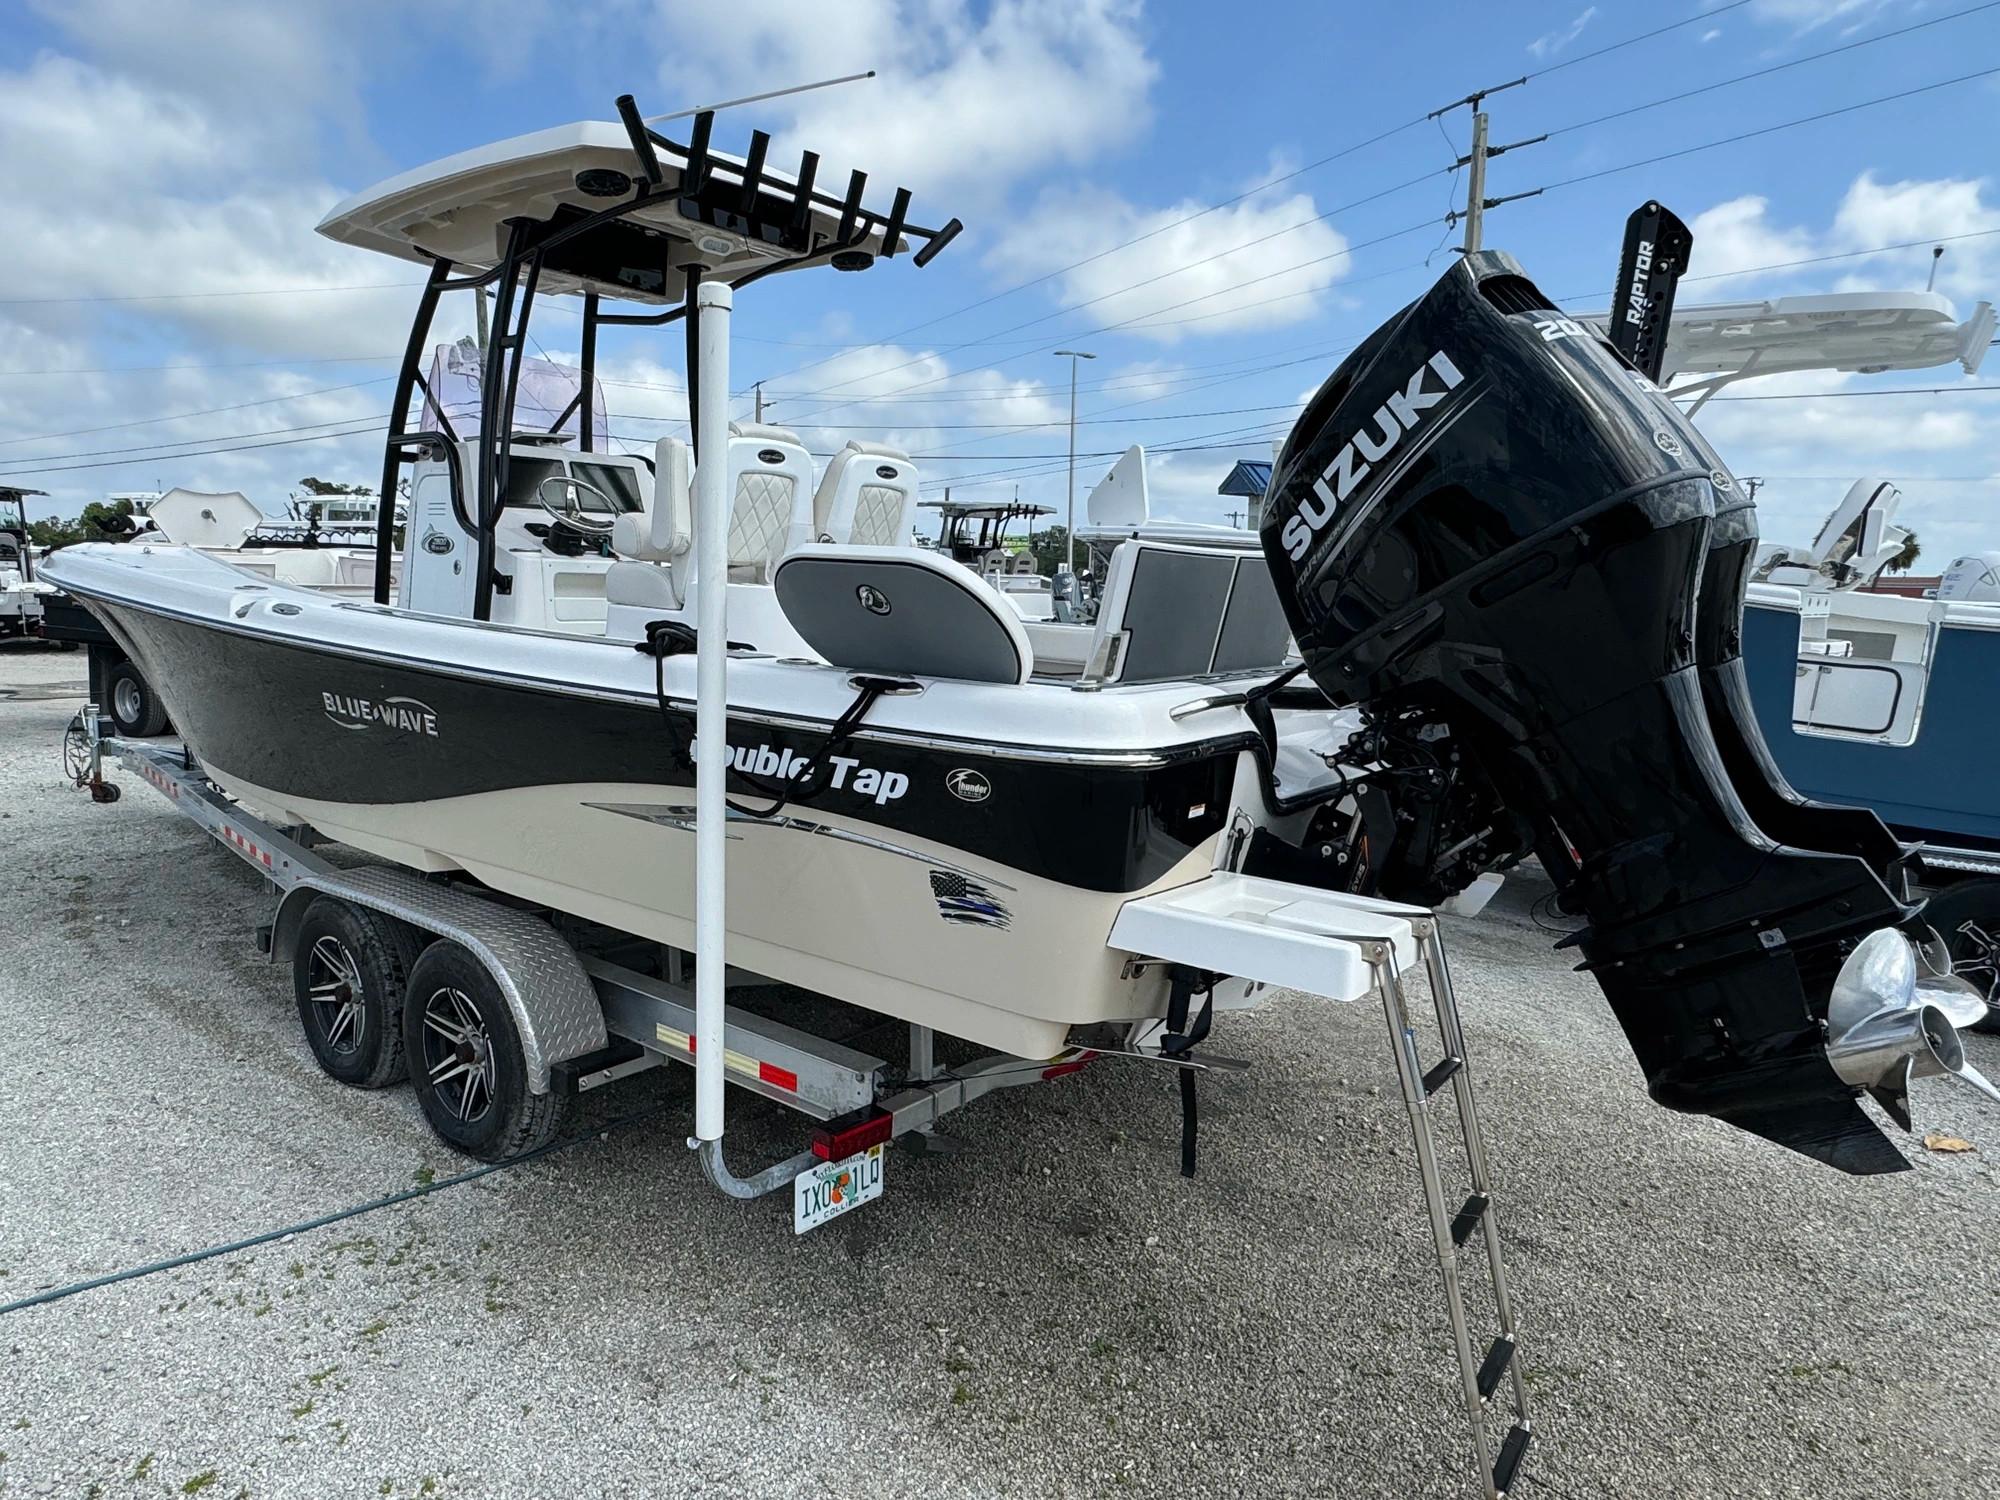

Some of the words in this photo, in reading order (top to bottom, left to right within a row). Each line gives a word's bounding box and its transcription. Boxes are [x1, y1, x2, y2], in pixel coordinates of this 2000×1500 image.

[1626, 241, 1655, 325] RAPTOR
[1281, 350, 1465, 561] SUZUKI
[322, 692, 373, 720] BLUE
[378, 704, 439, 737] WAVE
[829, 755, 909, 805] Tap
